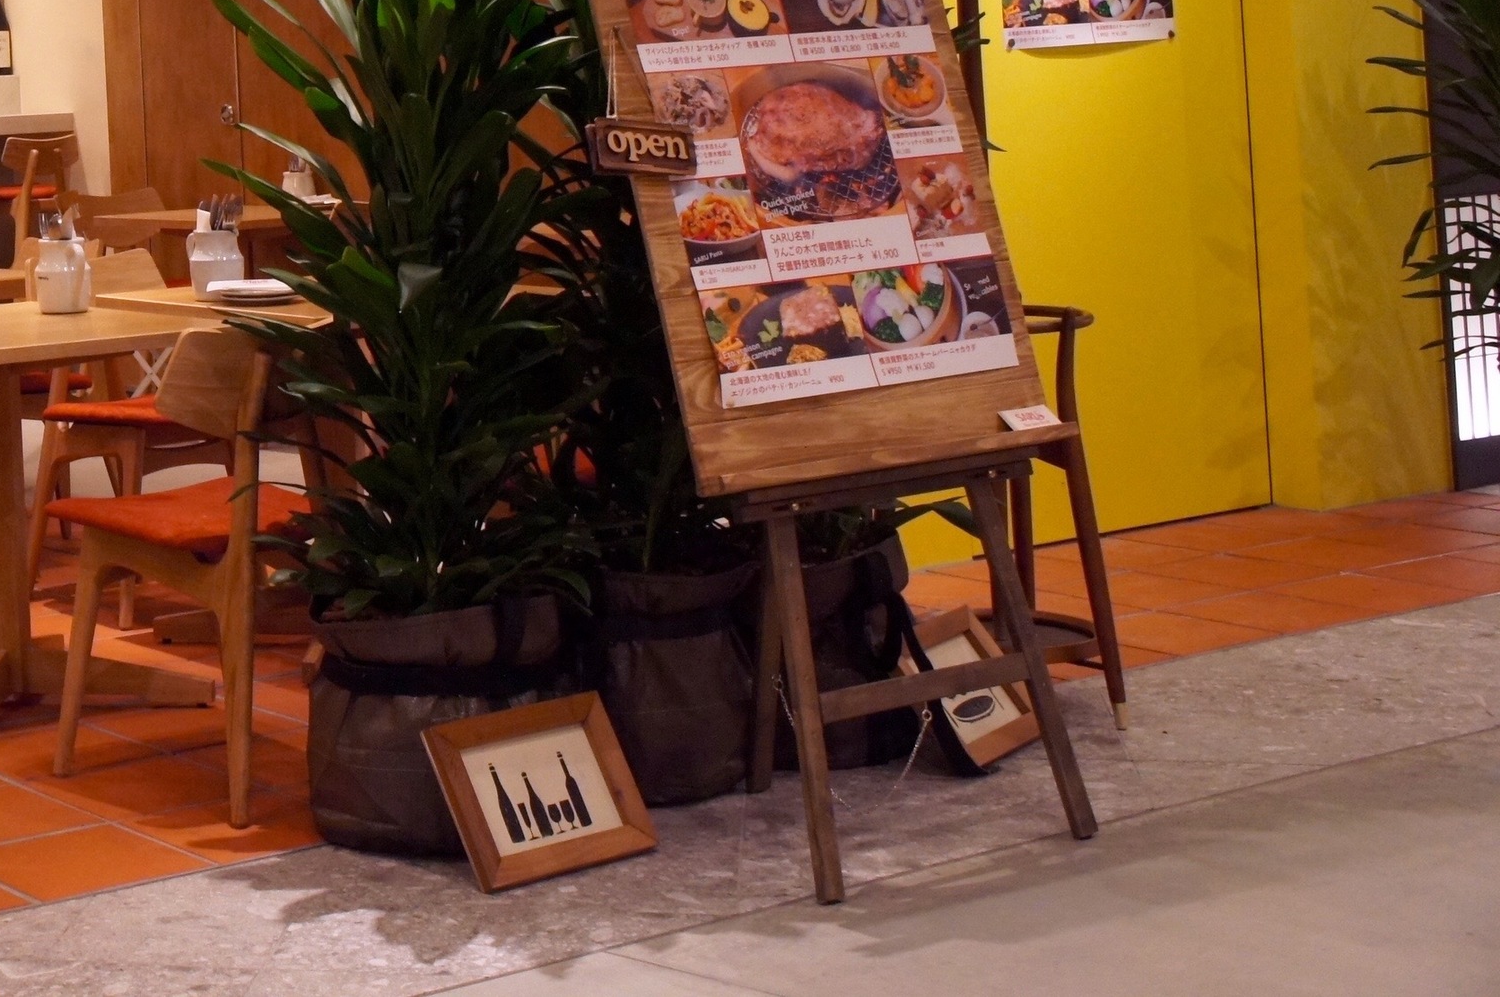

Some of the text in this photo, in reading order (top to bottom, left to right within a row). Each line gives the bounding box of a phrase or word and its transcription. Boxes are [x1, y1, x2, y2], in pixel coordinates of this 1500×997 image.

[607, 130, 689, 162] open
[760, 187, 816, 210] Quick smoked
[789, 201, 809, 216] pork
[769, 230, 815, 244] SARU名物!
[871, 247, 899, 260] ¥1,900
[751, 345, 784, 361] campagne
